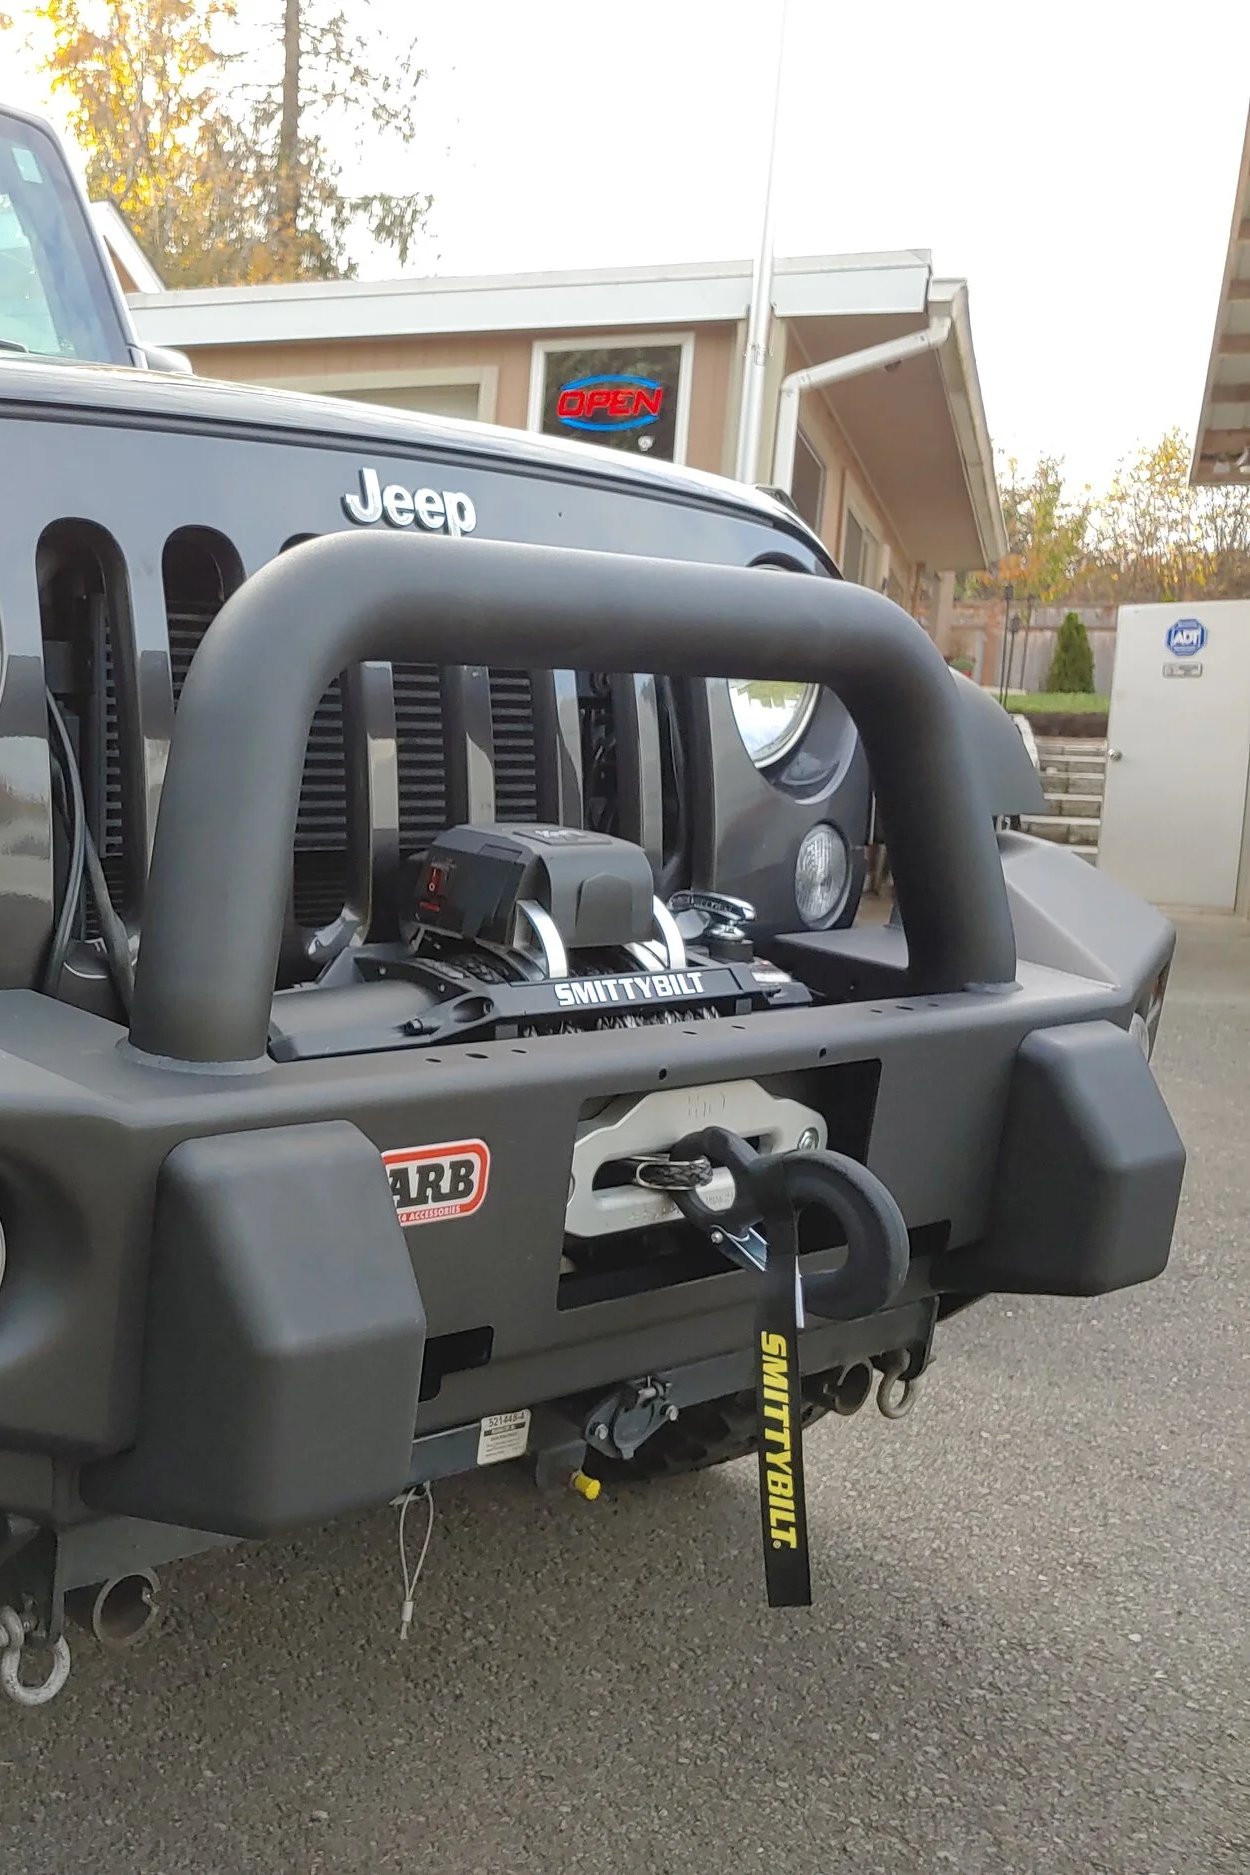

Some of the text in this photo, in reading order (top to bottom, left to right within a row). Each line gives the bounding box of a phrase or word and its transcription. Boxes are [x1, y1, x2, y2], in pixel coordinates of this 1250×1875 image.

[557, 387, 664, 418] OPEN
[341, 467, 477, 537] Jeep
[1171, 628, 1200, 646] ADT
[554, 972, 705, 1006] SMITTYBILT
[389, 1159, 475, 1208] ARB
[409, 1205, 461, 1221] ACCESSORIES
[760, 1330, 798, 1549] SMITTYBILT
